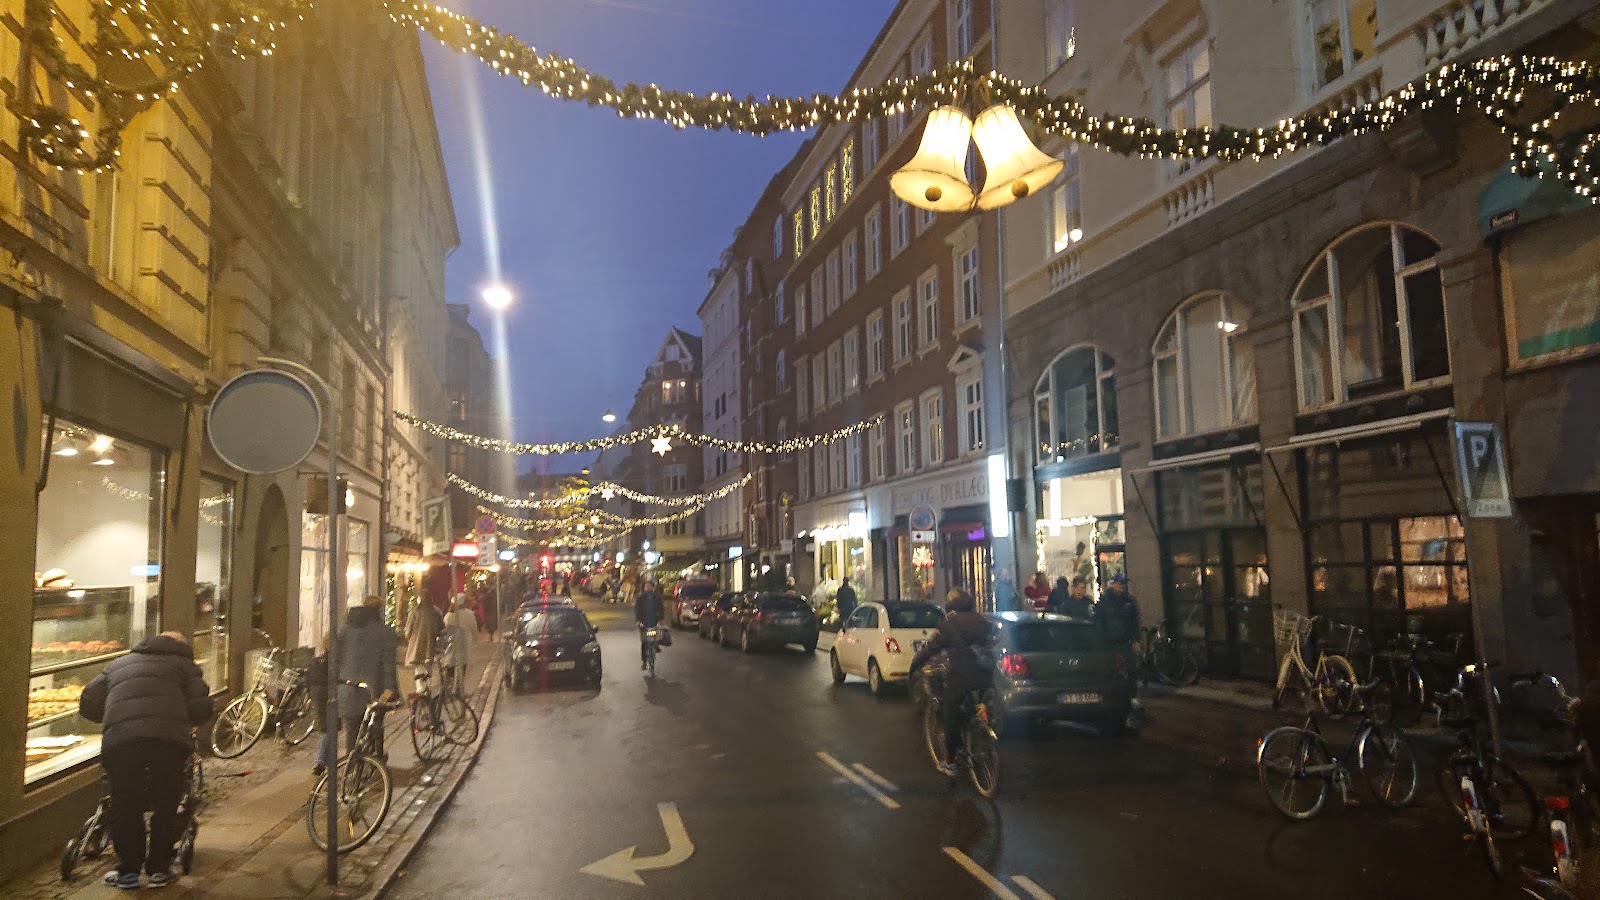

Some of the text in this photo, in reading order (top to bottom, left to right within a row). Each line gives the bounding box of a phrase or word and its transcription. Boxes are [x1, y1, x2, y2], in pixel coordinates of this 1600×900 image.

[1470, 435, 1488, 468] P
[941, 475, 990, 503] DYRLÆG
[428, 505, 439, 526] P
